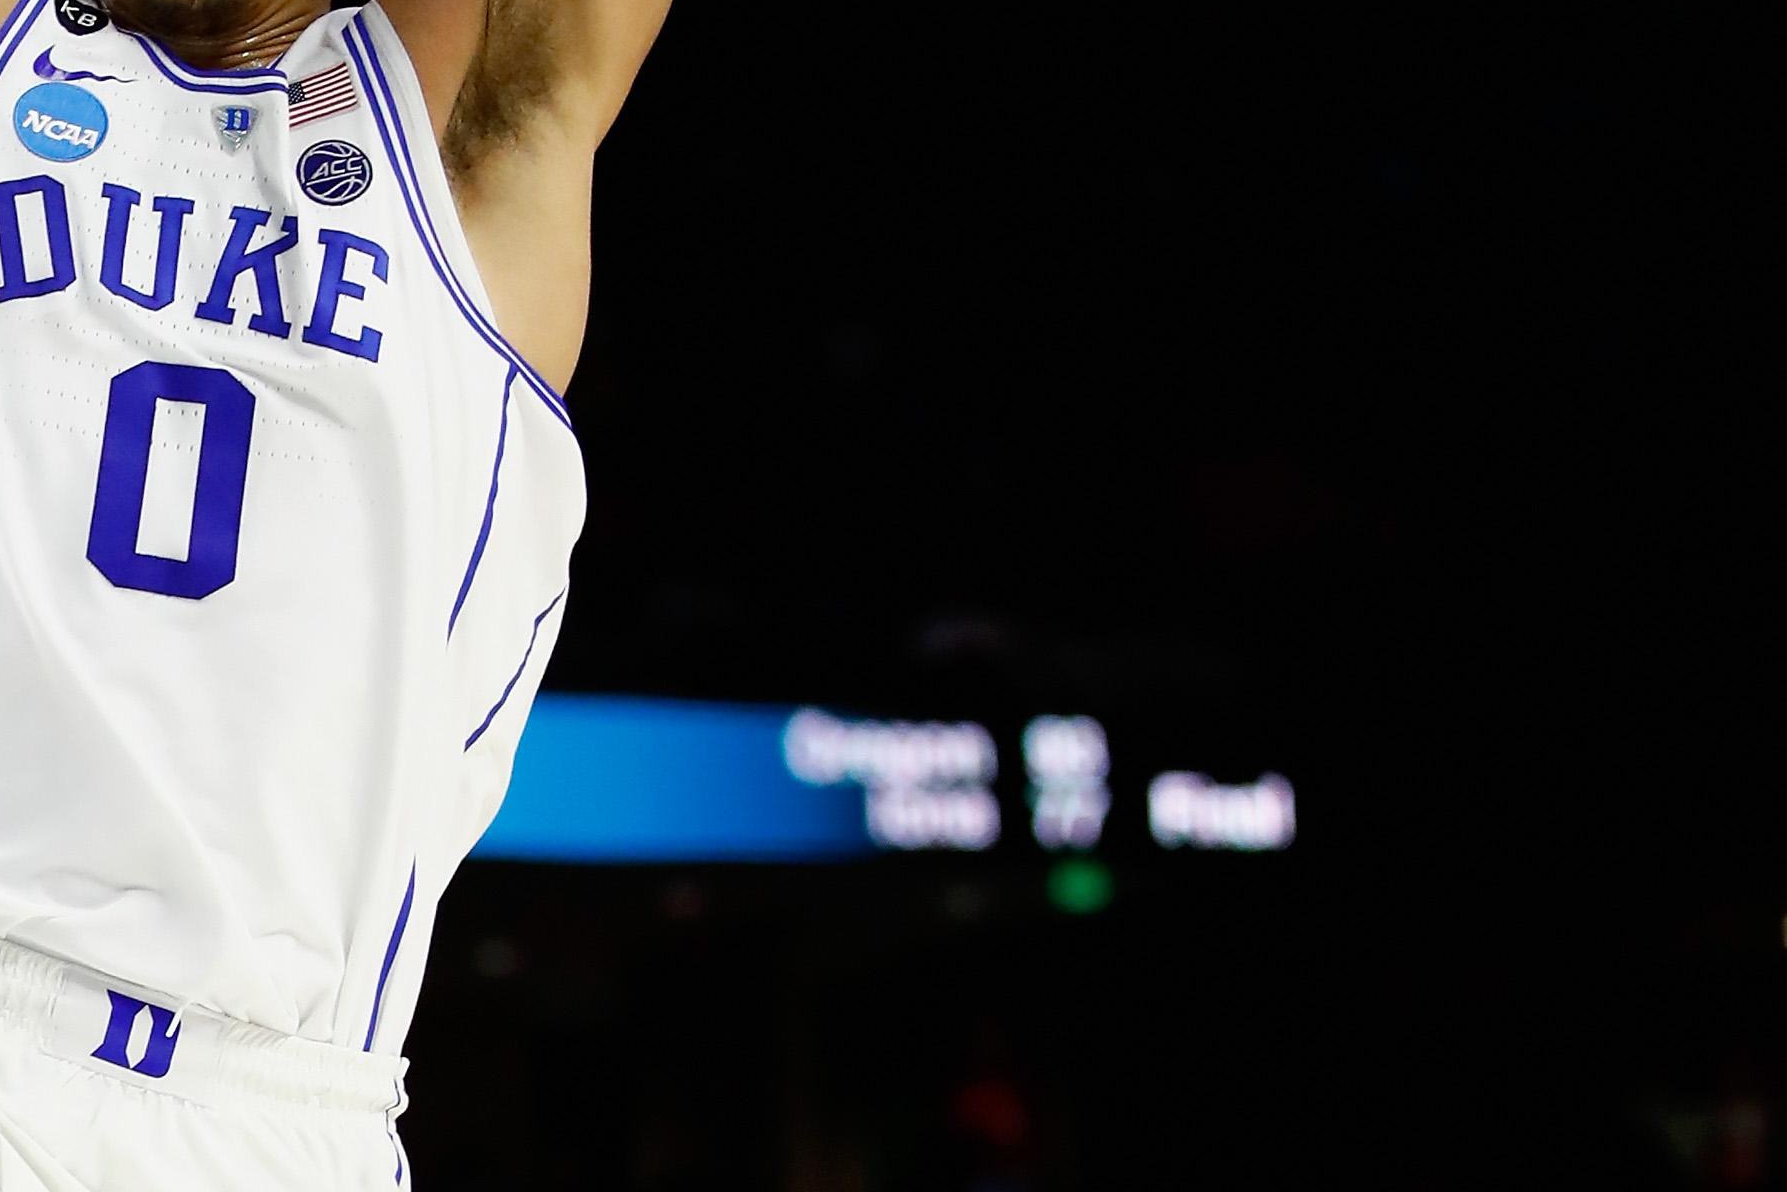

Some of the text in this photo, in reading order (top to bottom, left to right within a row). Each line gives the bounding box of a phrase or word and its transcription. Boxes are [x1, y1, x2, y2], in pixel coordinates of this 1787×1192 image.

[60, 0, 98, 27] KB
[21, 109, 100, 149] NCAA
[308, 155, 364, 181] ACC
[86, 360, 256, 600] 0
